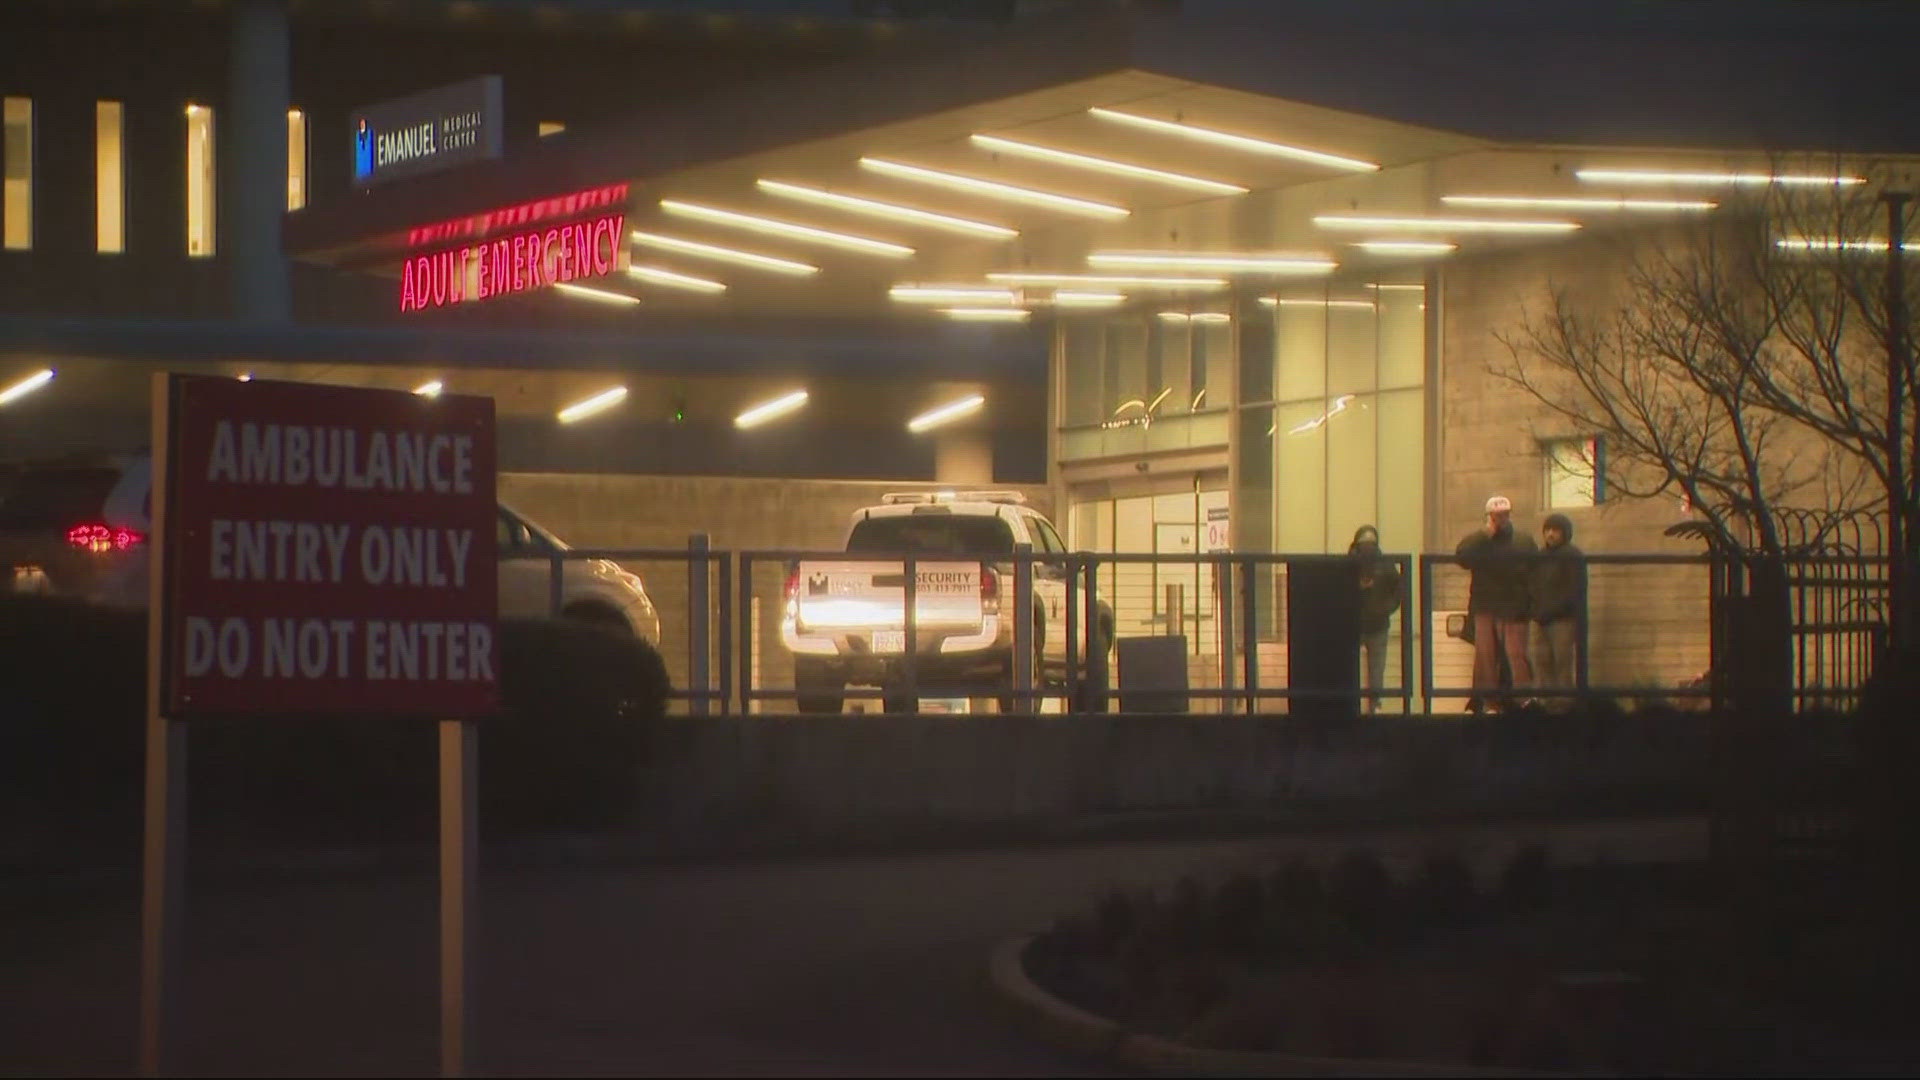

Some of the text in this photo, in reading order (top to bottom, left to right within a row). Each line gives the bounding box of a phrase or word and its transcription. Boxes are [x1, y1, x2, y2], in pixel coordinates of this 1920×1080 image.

[378, 122, 436, 166] EMANUEL
[444, 112, 481, 132] MEDICAL
[444, 131, 475, 150] CENTER
[401, 215, 624, 313] ADULT EMERGENCY
[208, 420, 473, 494] AMBULANCE
[210, 519, 472, 587] ENTRY ONLY
[915, 572, 971, 584] SECURITY
[185, 616, 495, 681] DO NOT ENTER
